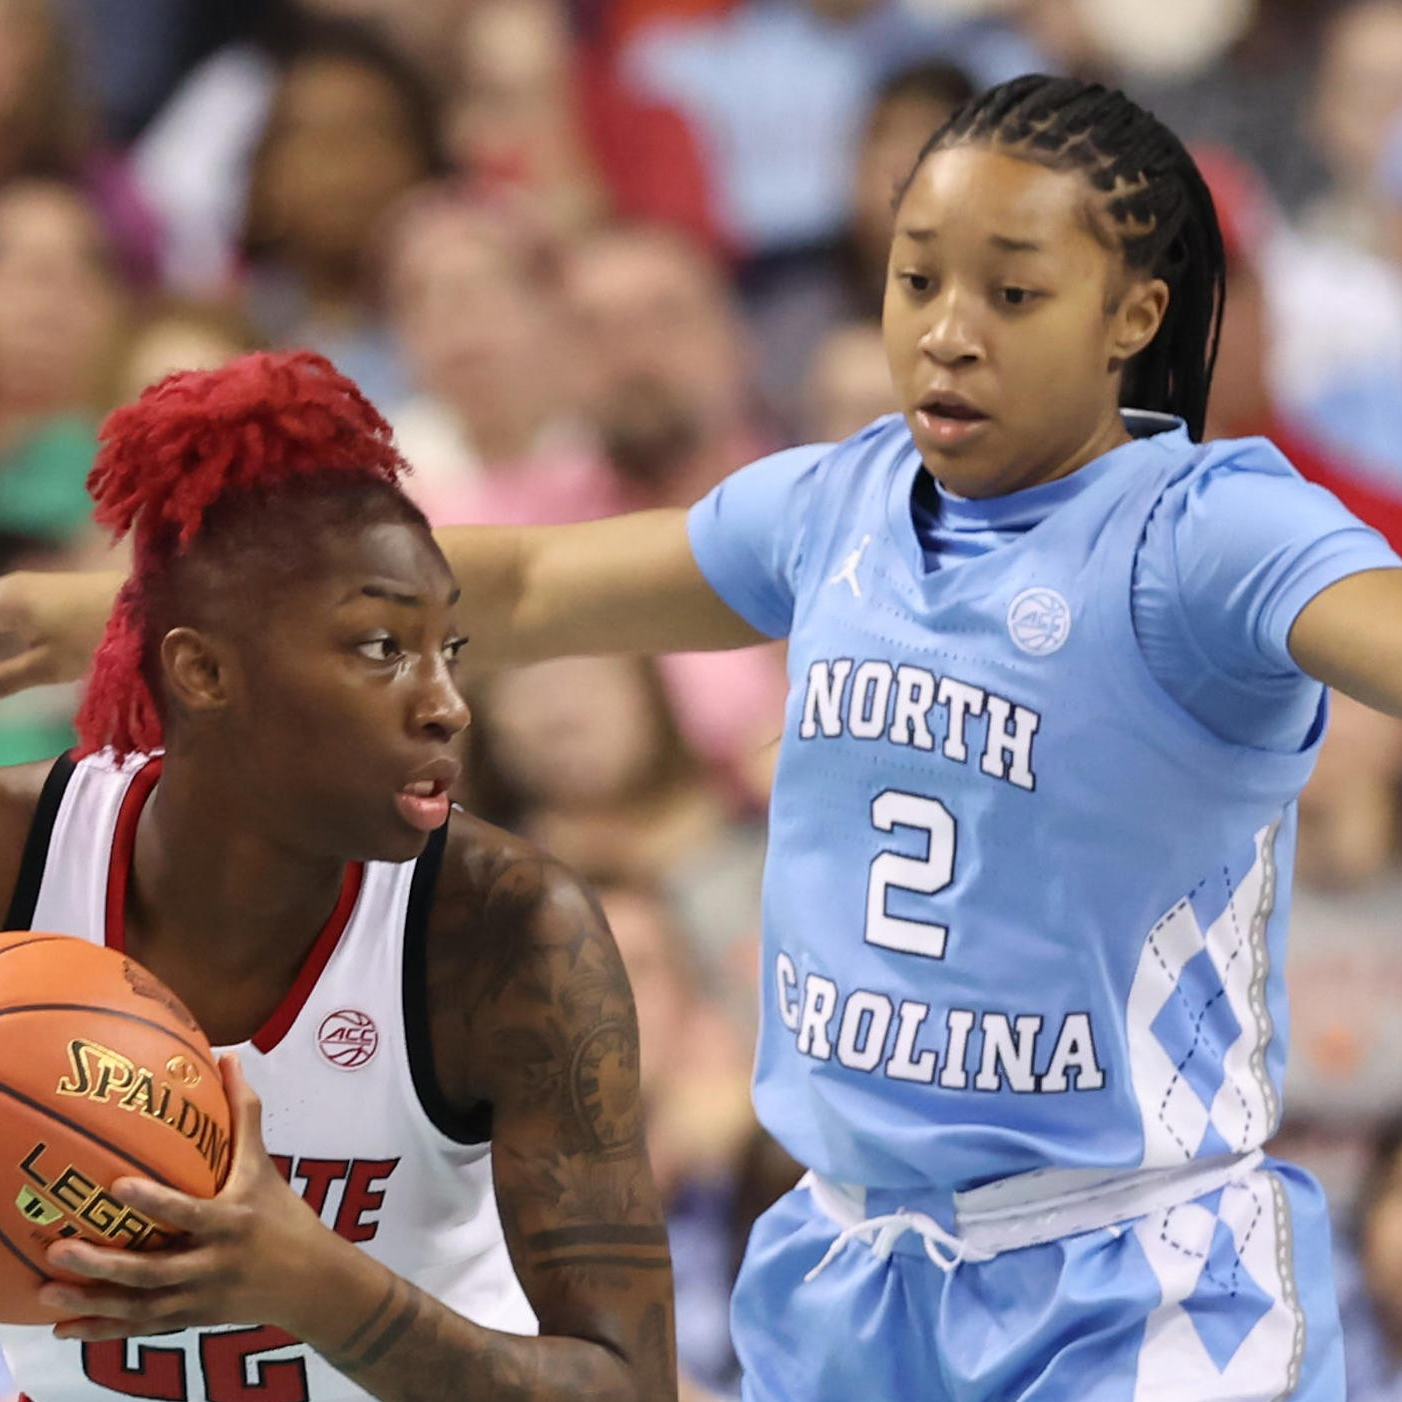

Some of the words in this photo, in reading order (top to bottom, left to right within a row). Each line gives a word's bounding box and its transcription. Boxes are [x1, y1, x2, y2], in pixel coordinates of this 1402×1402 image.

[799, 656, 1041, 792] NORTH
[863, 788, 957, 960] 2
[324, 1026, 375, 1043] ACC
[775, 950, 1106, 1093] CROLINA
